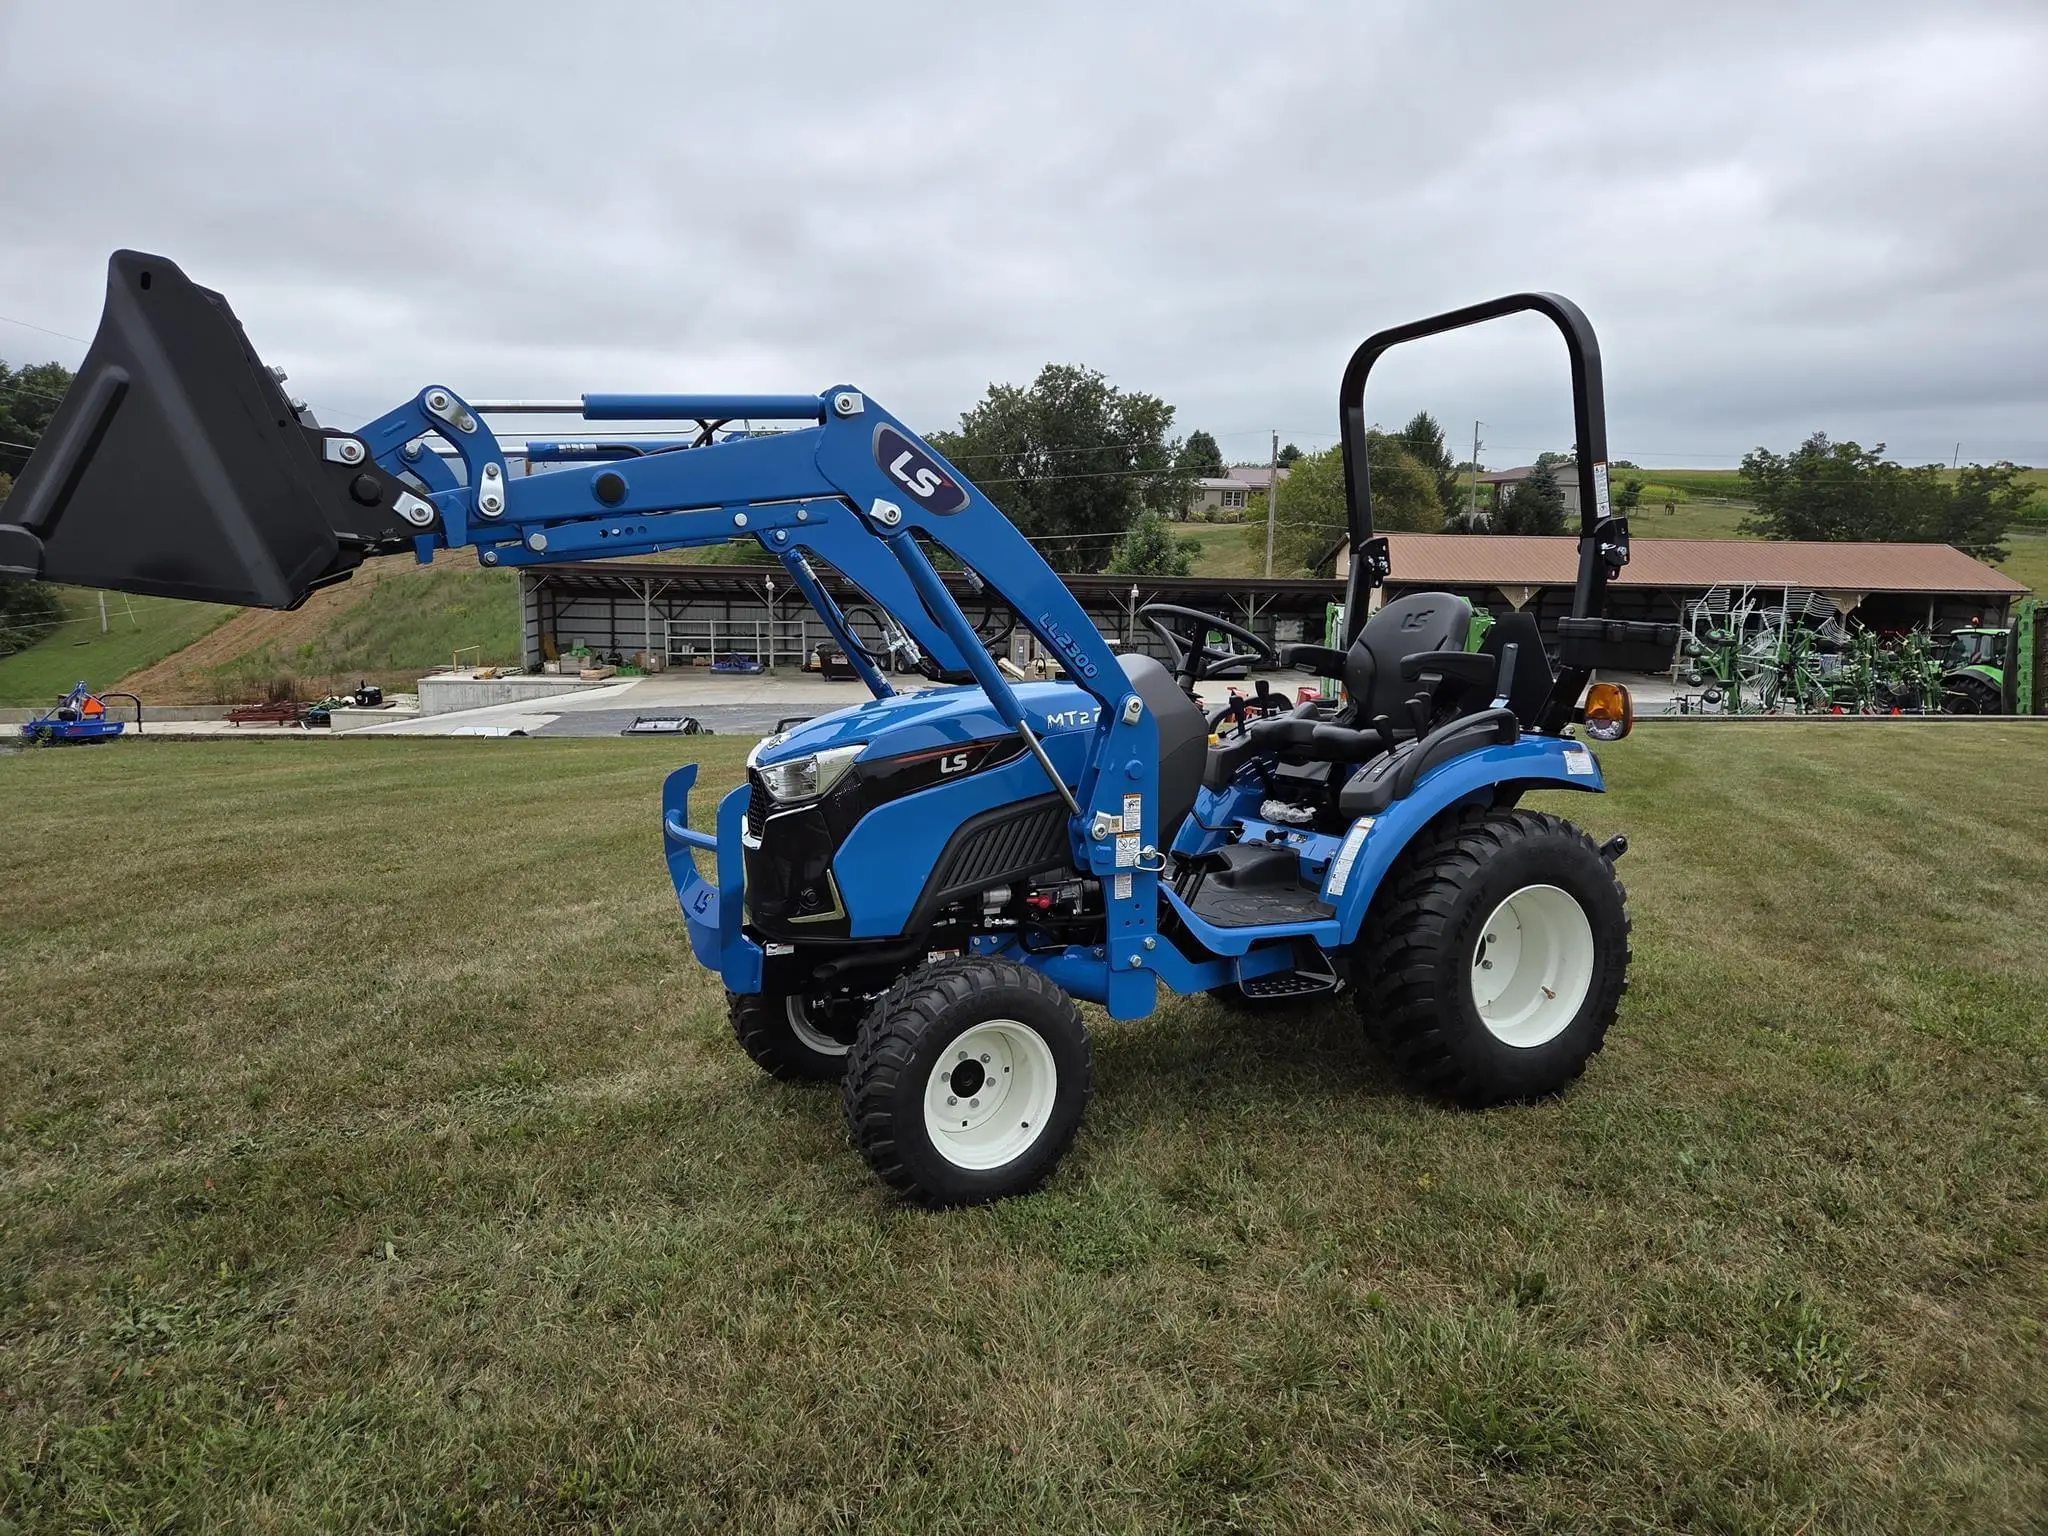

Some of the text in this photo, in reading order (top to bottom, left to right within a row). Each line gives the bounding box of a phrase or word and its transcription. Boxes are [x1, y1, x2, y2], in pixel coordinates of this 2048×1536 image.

[889, 450, 942, 497] LS
[1038, 611, 1099, 679] LL2300
[939, 753, 968, 774] LS
